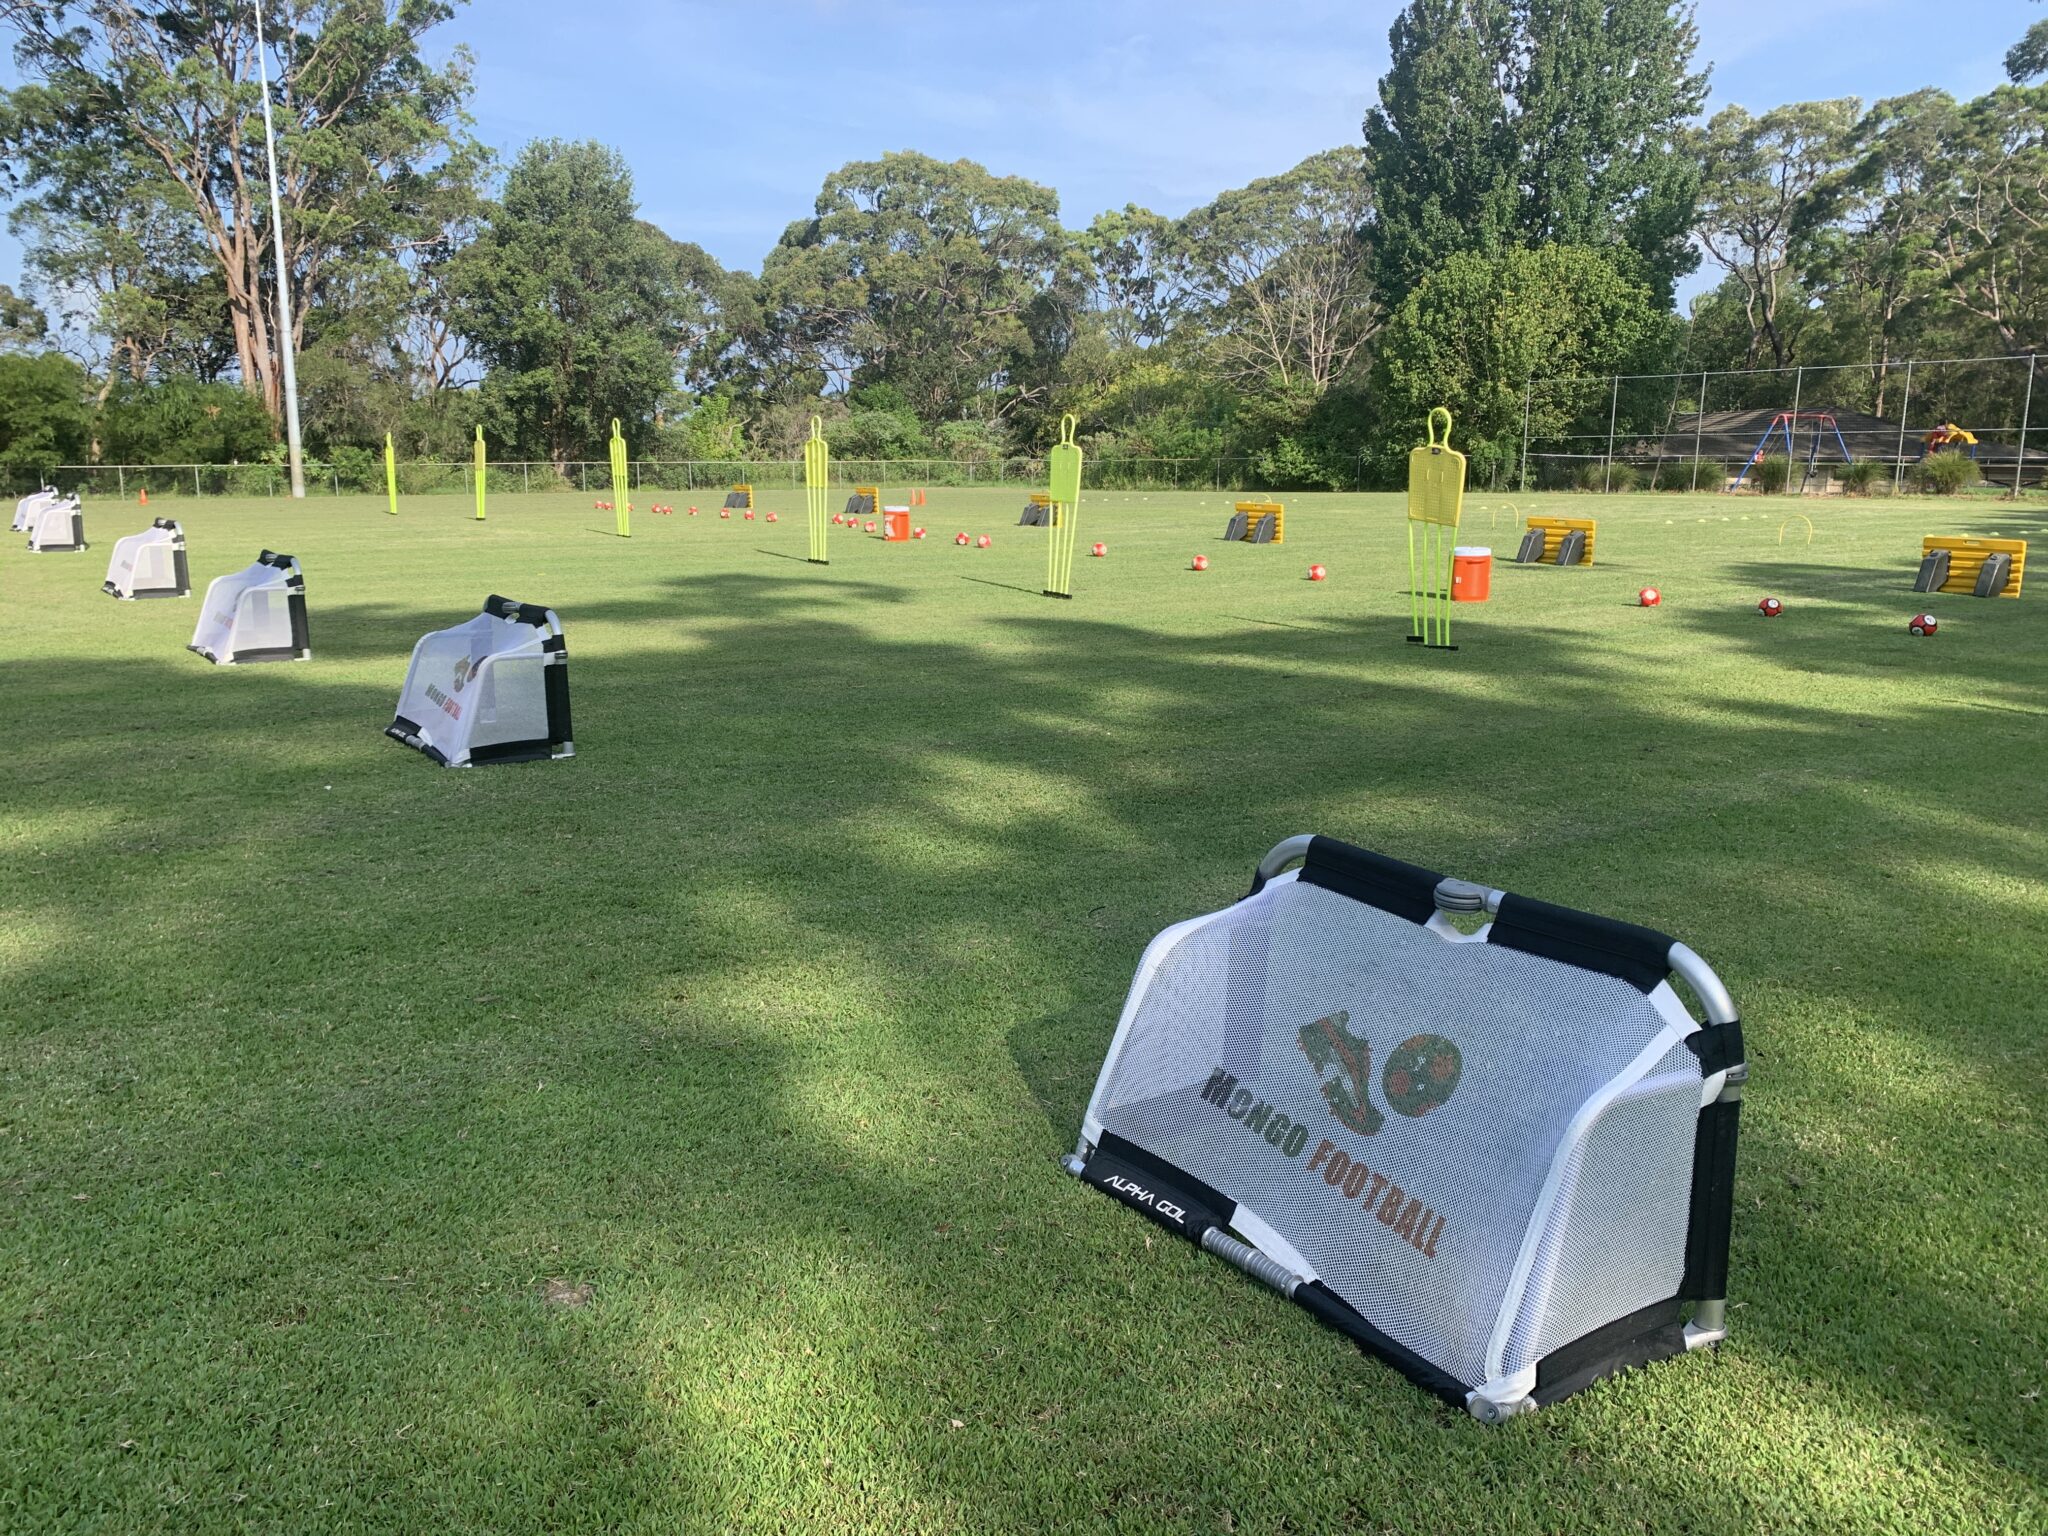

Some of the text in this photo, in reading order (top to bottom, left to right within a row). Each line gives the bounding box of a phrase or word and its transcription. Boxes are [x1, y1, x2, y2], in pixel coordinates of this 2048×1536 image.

[1103, 1175, 1186, 1224] ALPHA GOL
[1200, 1067, 1447, 1258] MONGO FOOTBALL
